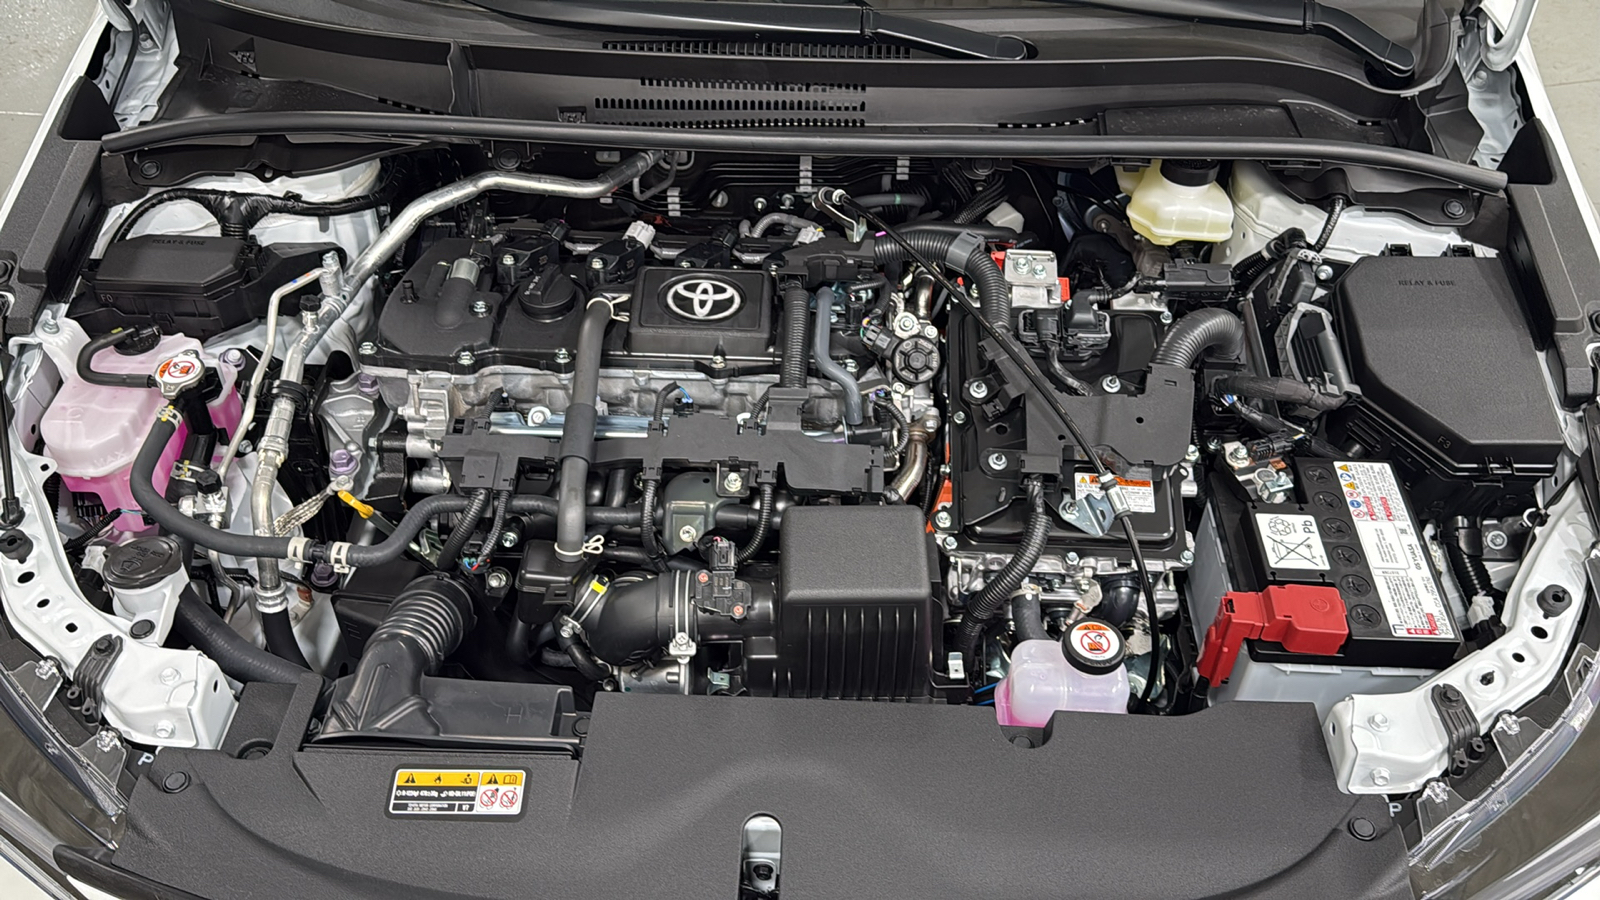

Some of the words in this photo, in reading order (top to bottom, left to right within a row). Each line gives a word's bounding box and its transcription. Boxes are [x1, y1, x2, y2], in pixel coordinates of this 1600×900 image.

[1437, 435, 1452, 449] F3
[1302, 520, 1315, 533] Pb
[137, 752, 154, 766] P
[1389, 802, 1402, 817] P
